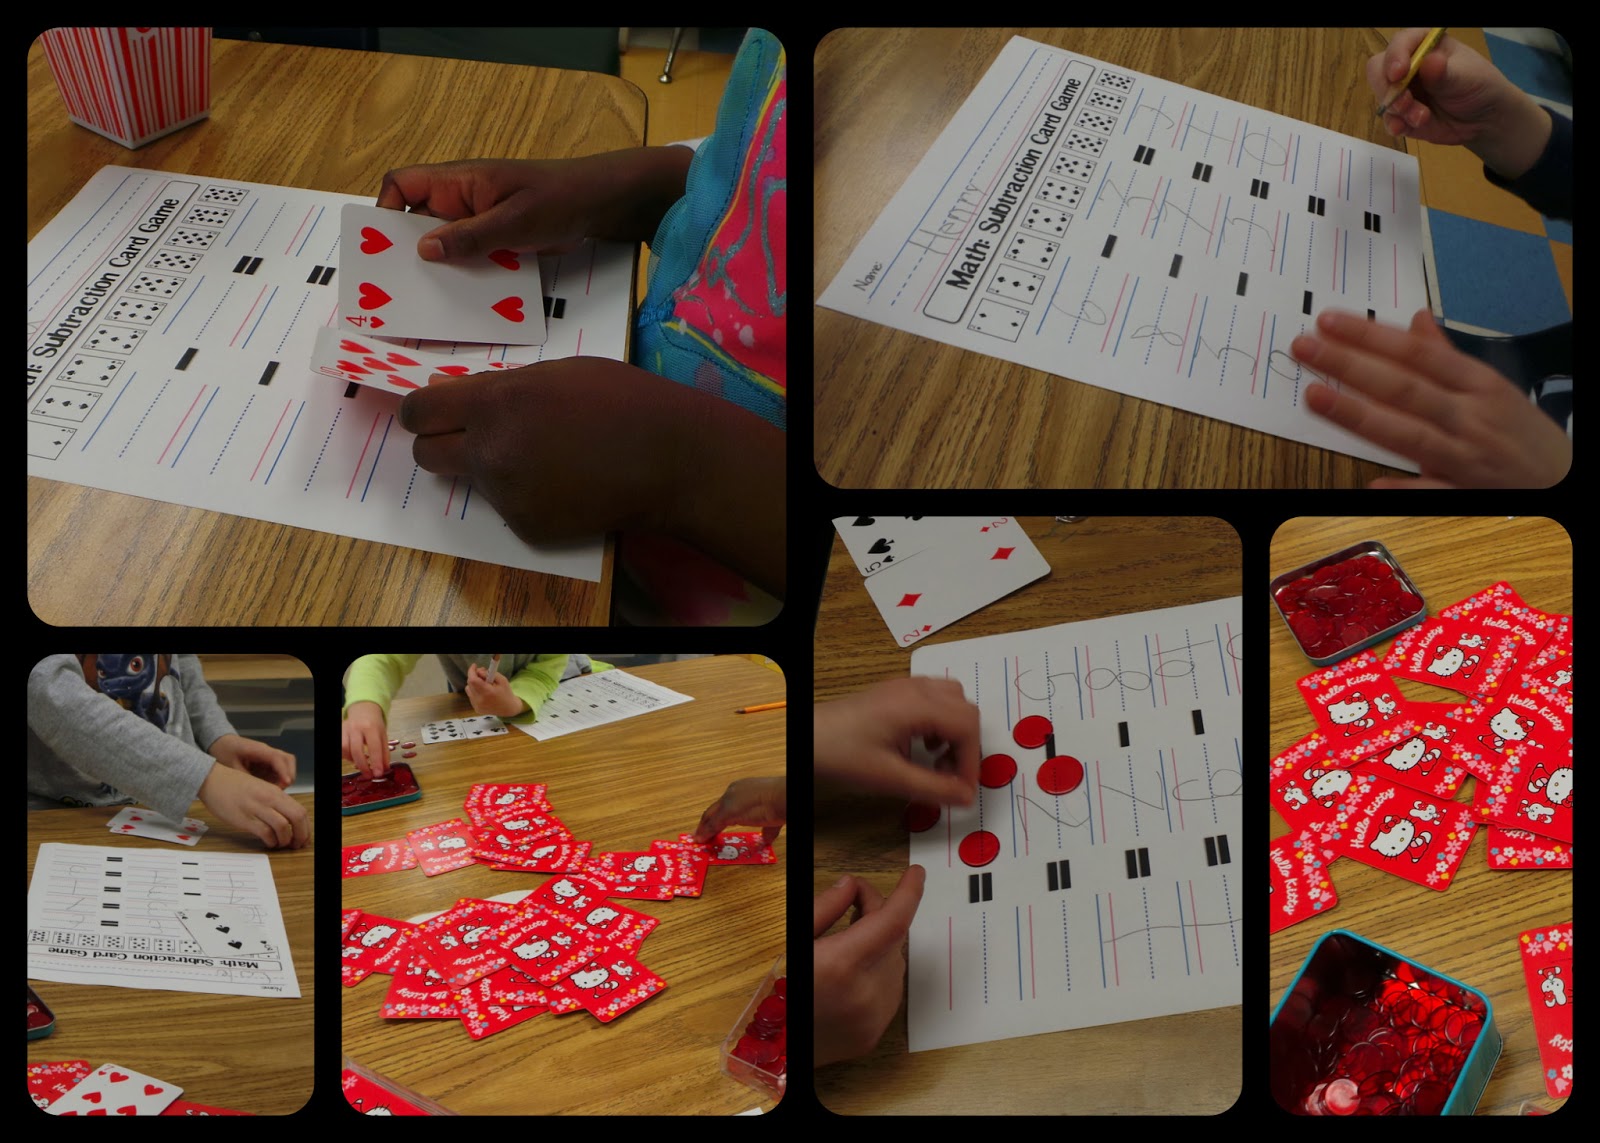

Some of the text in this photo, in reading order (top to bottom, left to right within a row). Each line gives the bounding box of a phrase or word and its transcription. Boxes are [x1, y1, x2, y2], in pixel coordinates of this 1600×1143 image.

[945, 77, 1082, 291] Math: Subtraction Card Game
[907, 182, 987, 256] Henry
[33, 197, 180, 359] Subtraction Card Game
[852, 261, 883, 292] Name:
[345, 315, 368, 327] 4
[1409, 625, 1444, 673] Hello Kitty
[1482, 616, 1537, 646] Hello Kitty
[1315, 673, 1380, 705] Hello Kitty
[1507, 693, 1566, 732] Hello Kitty
[1350, 787, 1395, 849] Hello Kitty
[1270, 847, 1299, 916] Hello Kitty
[500, 919, 549, 950] Hello Kitty
[48, 946, 259, 969] Math: Subtraction Card Game
